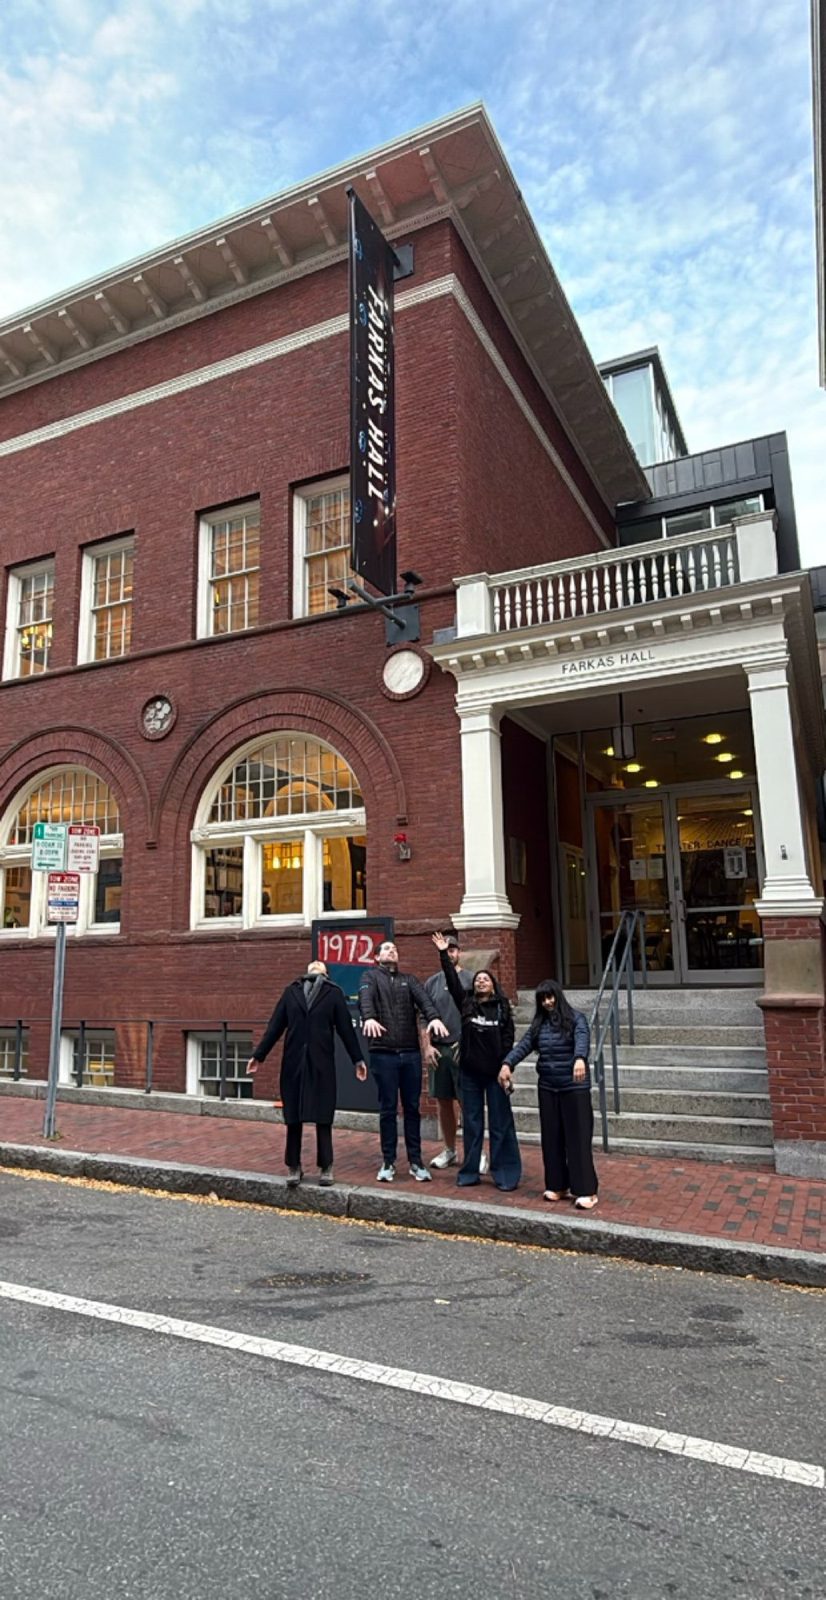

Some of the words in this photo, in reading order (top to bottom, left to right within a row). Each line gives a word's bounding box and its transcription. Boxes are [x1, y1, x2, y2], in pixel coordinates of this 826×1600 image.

[368, 285, 385, 414] FARKAS
[368, 418, 384, 500] HALL
[562, 656, 615, 674] FARKAS
[620, 649, 655, 665] HALL
[656, 840, 700, 852] TTER
[707, 838, 741, 848] DANCE
[57, 885, 78, 893] PARKING
[322, 934, 375, 963] 1972
